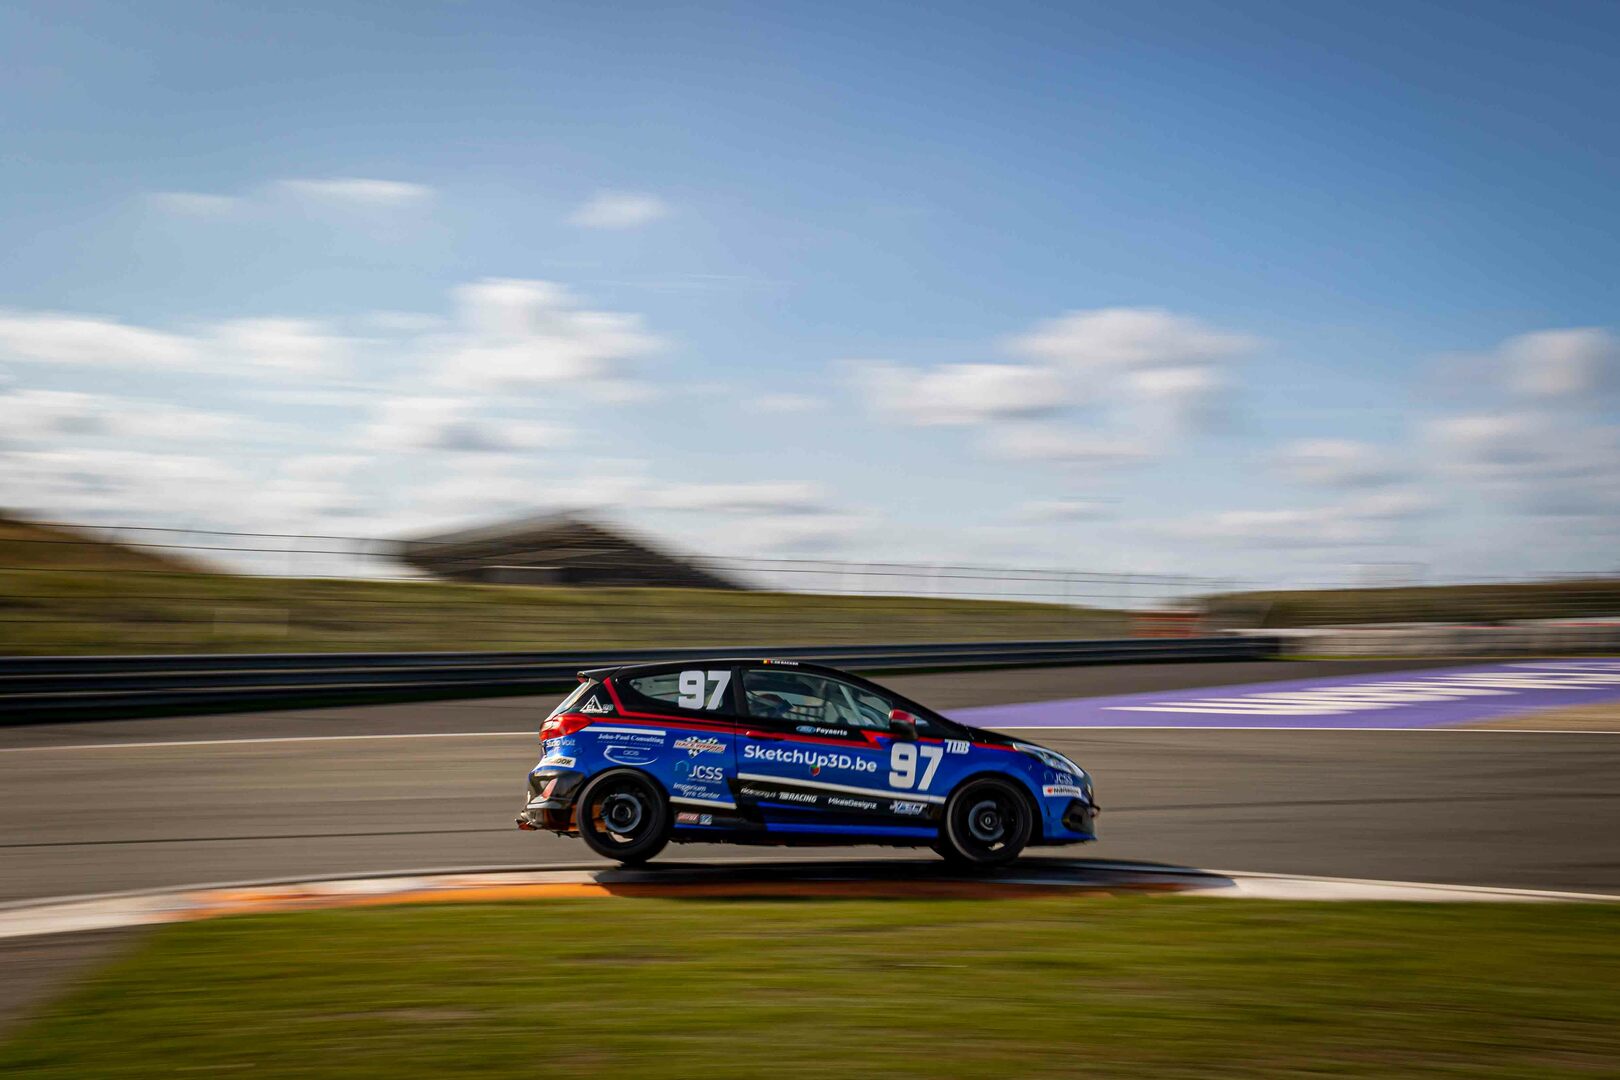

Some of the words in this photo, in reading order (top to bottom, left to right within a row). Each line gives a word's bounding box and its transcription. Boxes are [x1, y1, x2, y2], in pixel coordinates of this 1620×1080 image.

[678, 670, 732, 710] 97
[688, 765, 723, 780] JCSS
[743, 745, 878, 772] SketchUp3D.be
[888, 742, 944, 791] 97
